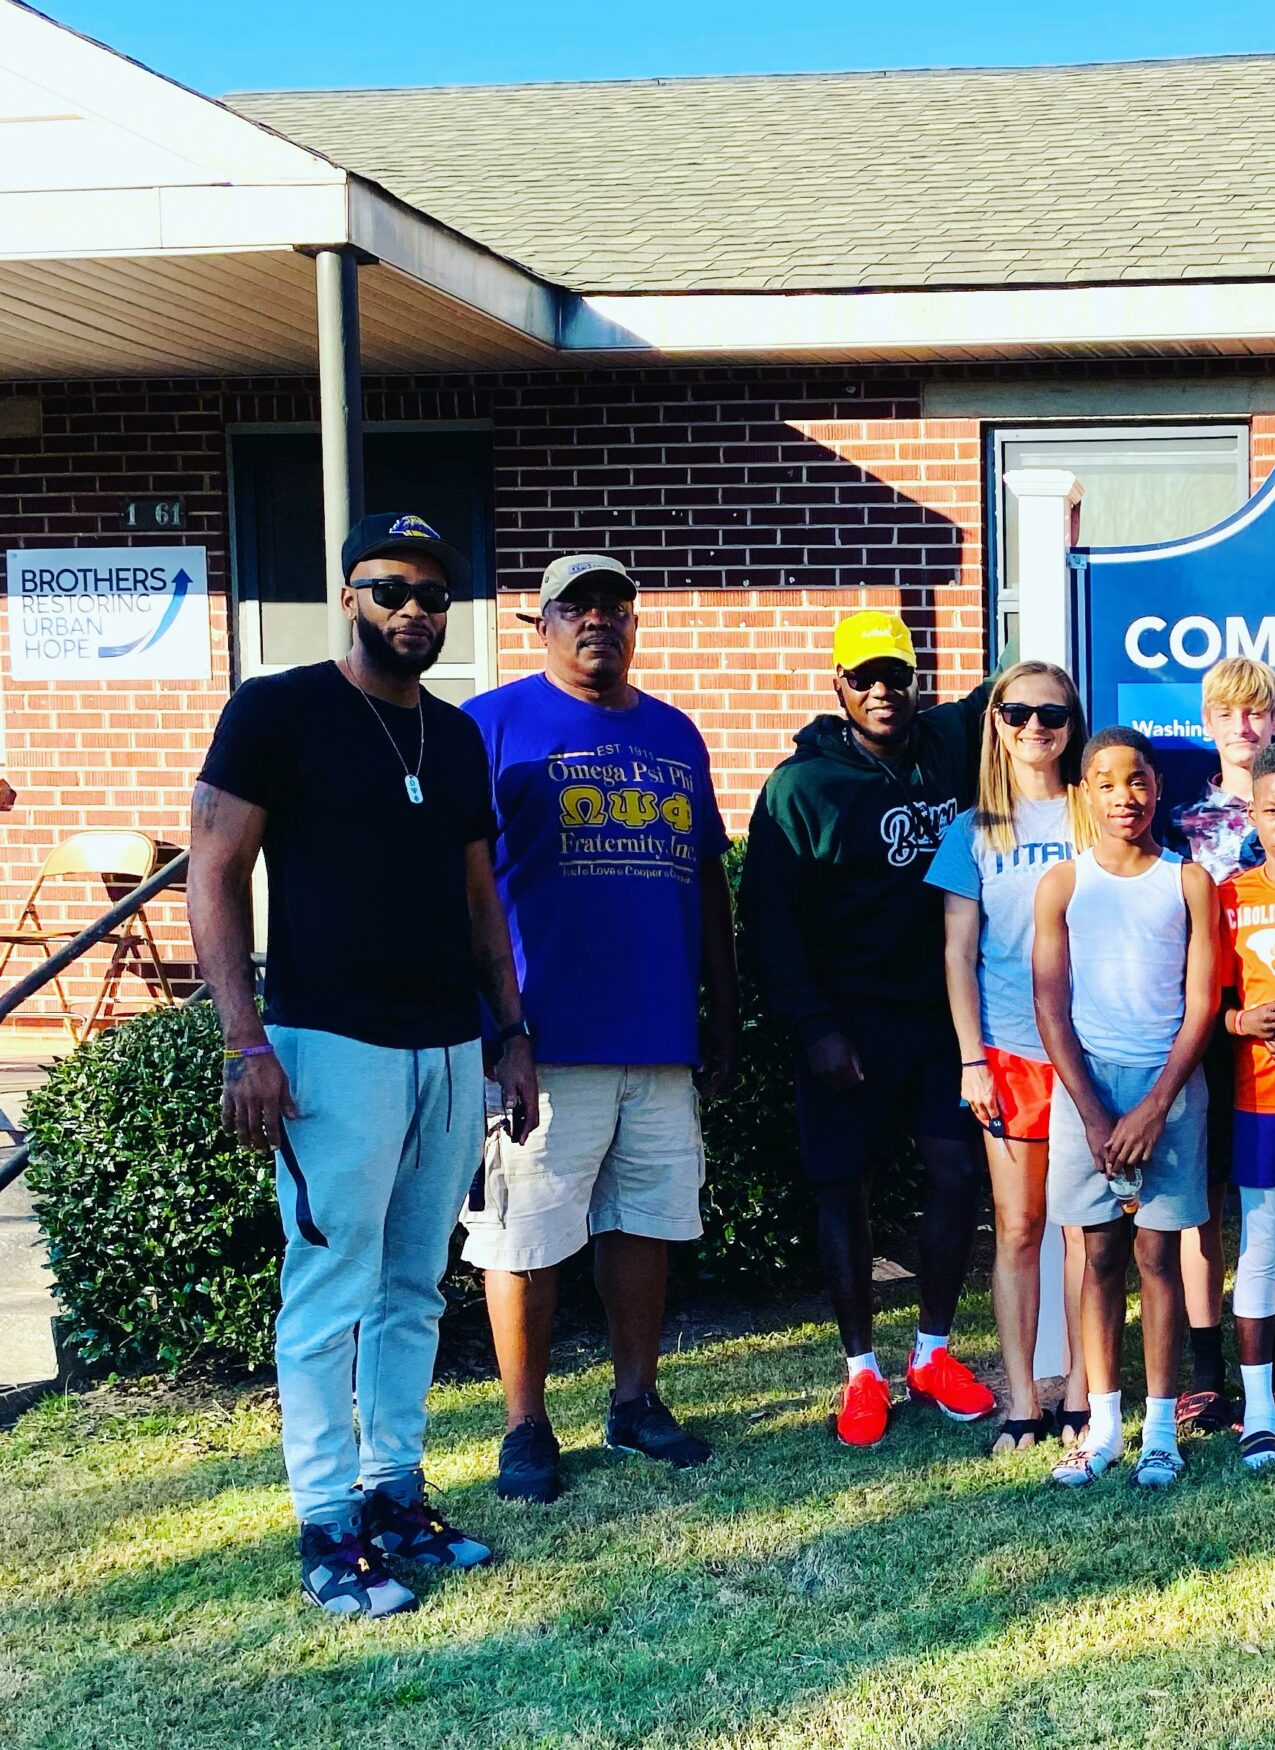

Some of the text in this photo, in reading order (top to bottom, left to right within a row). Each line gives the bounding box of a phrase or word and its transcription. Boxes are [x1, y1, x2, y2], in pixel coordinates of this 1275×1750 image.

[21, 567, 167, 593] BROTHERS
[22, 593, 152, 614] RESTORING
[23, 617, 103, 637] URBAN
[25, 639, 91, 660] HOPE
[1132, 720, 1215, 742] Washing
[548, 761, 694, 792] Omega Psi Phi
